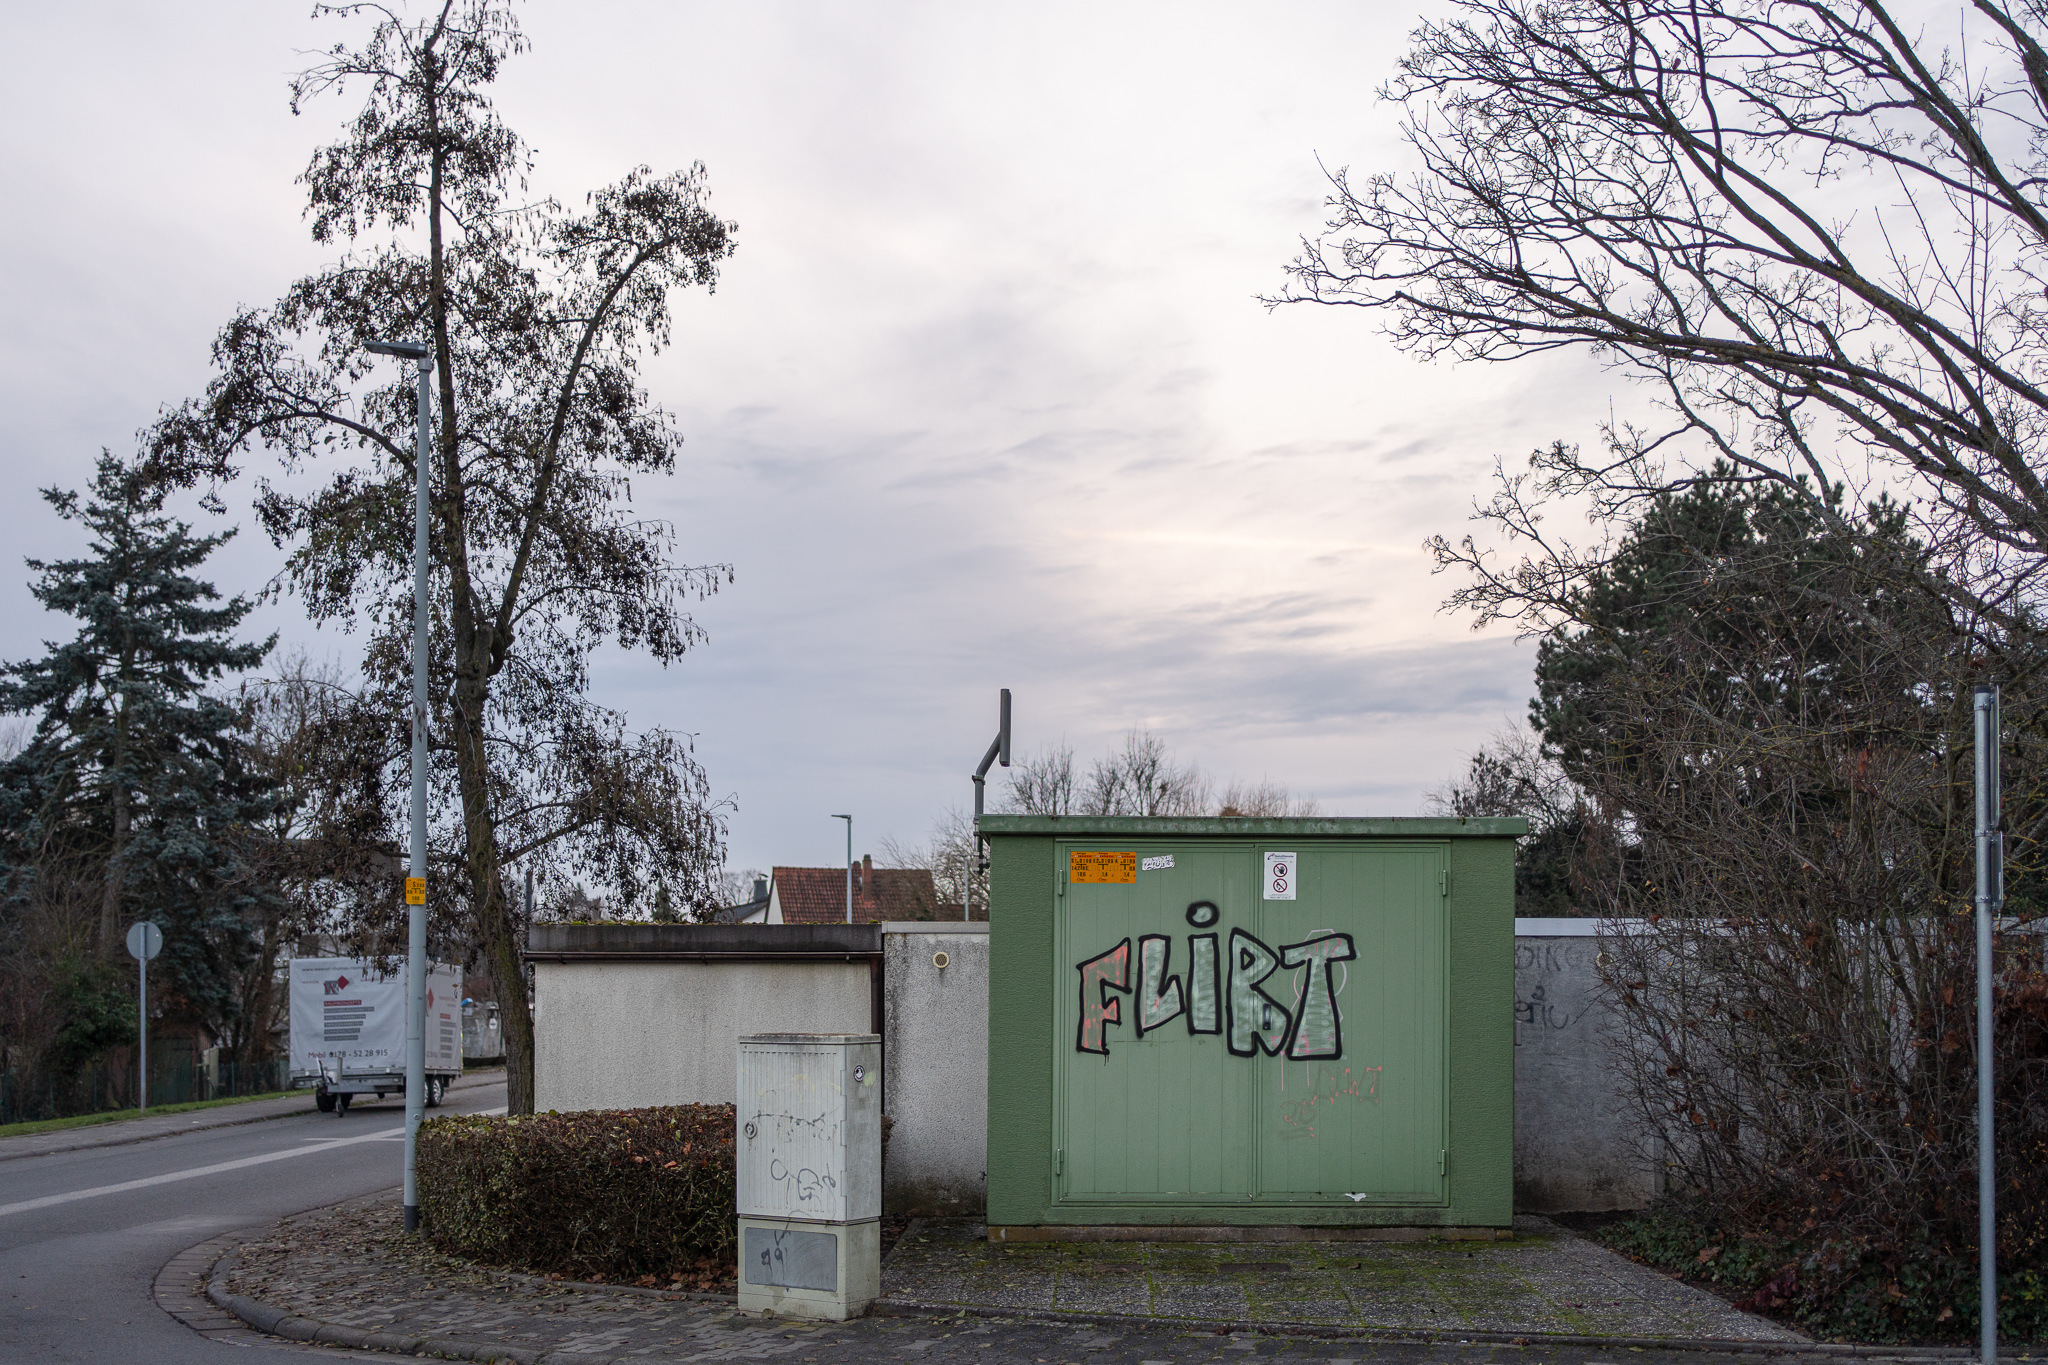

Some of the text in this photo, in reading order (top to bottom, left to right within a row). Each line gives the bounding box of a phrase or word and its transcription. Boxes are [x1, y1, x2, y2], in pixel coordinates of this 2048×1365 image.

[308, 1051, 326, 1059] Mobil
[353, 1050, 363, 1058] 52
[365, 1049, 374, 1057] 28
[375, 1048, 388, 1057] 915
